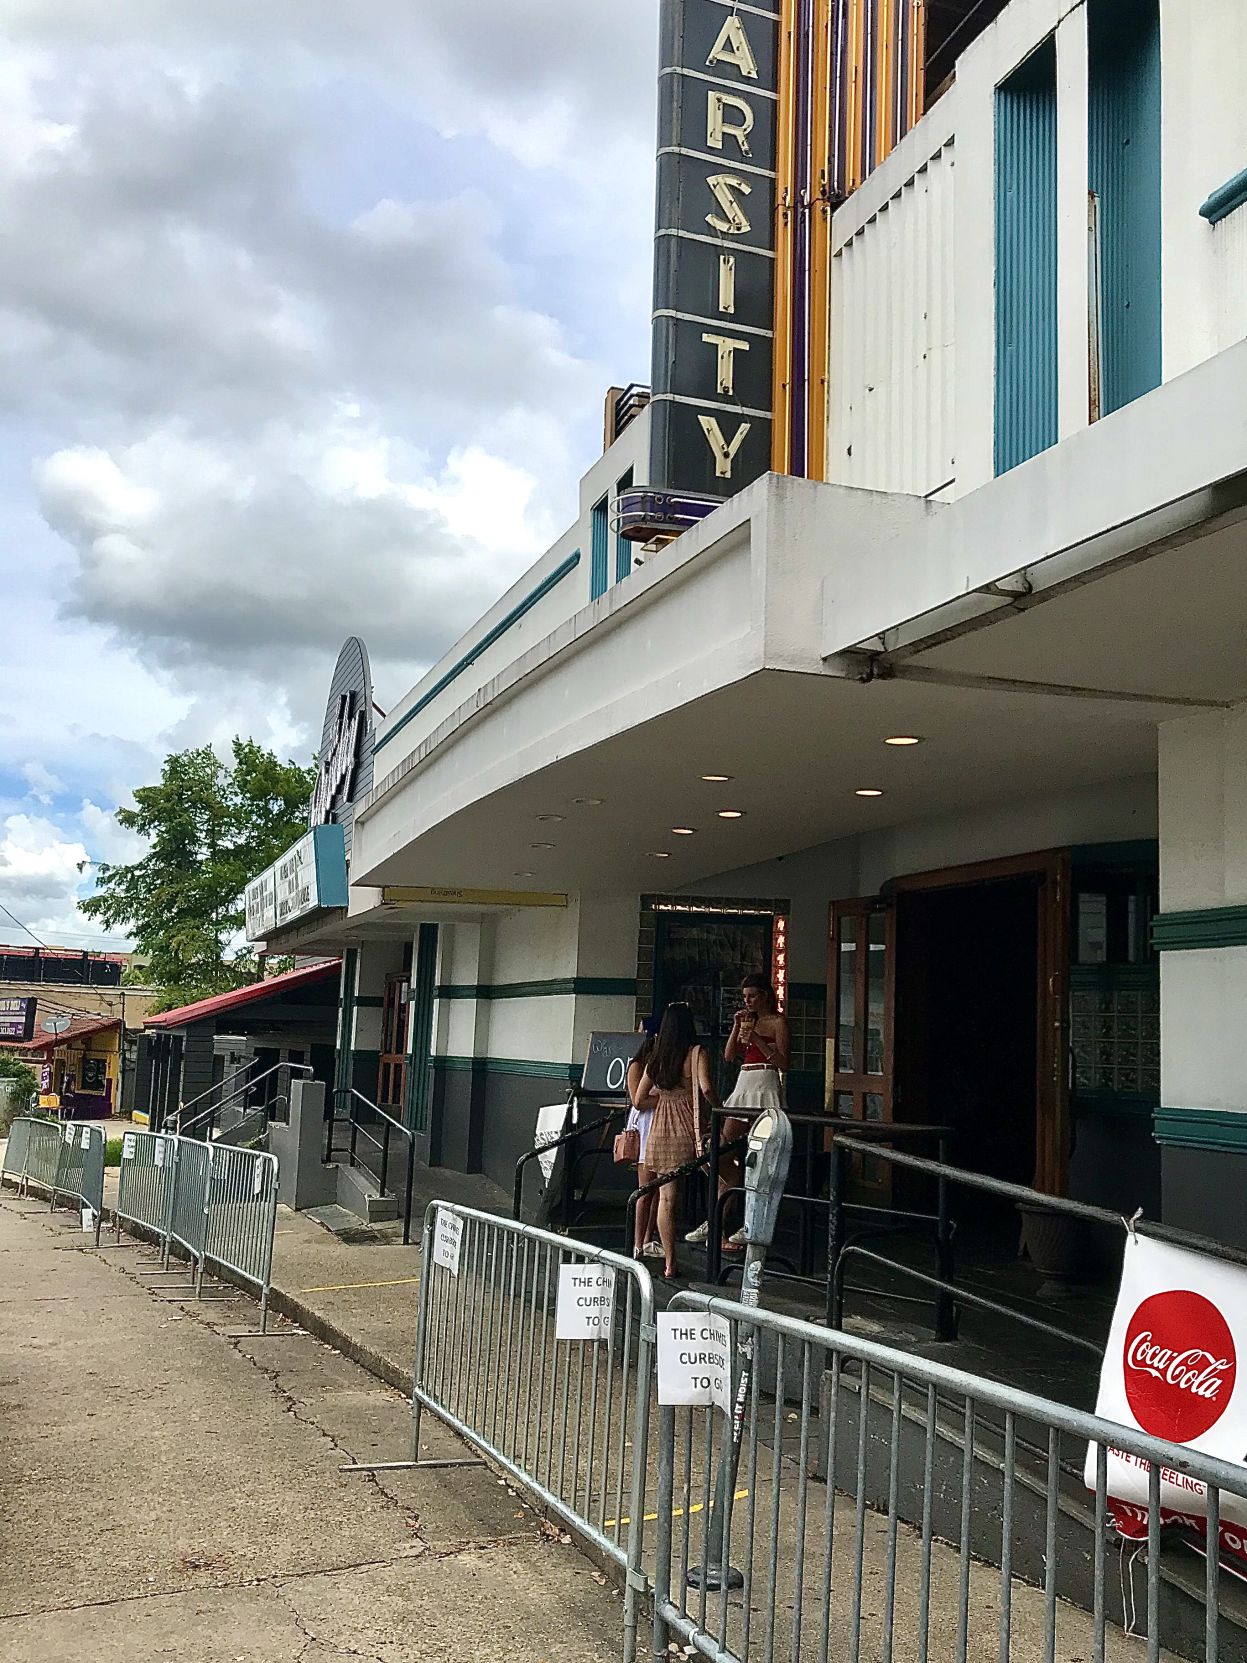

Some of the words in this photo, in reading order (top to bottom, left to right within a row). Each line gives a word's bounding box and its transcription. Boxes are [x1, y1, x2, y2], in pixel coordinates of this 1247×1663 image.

[571, 1277, 593, 1287] THE
[595, 1276, 612, 1288] CHI
[576, 1296, 610, 1307] CURBS
[585, 1316, 600, 1326] TO
[603, 1316, 610, 1326] G
[671, 1328, 696, 1341] THE
[1127, 1331, 1233, 1399] Coca-Cola
[691, 1376, 711, 1389] TO
[736, 1370, 749, 1402] MOIST
[1160, 1465, 1204, 1495] EELING
